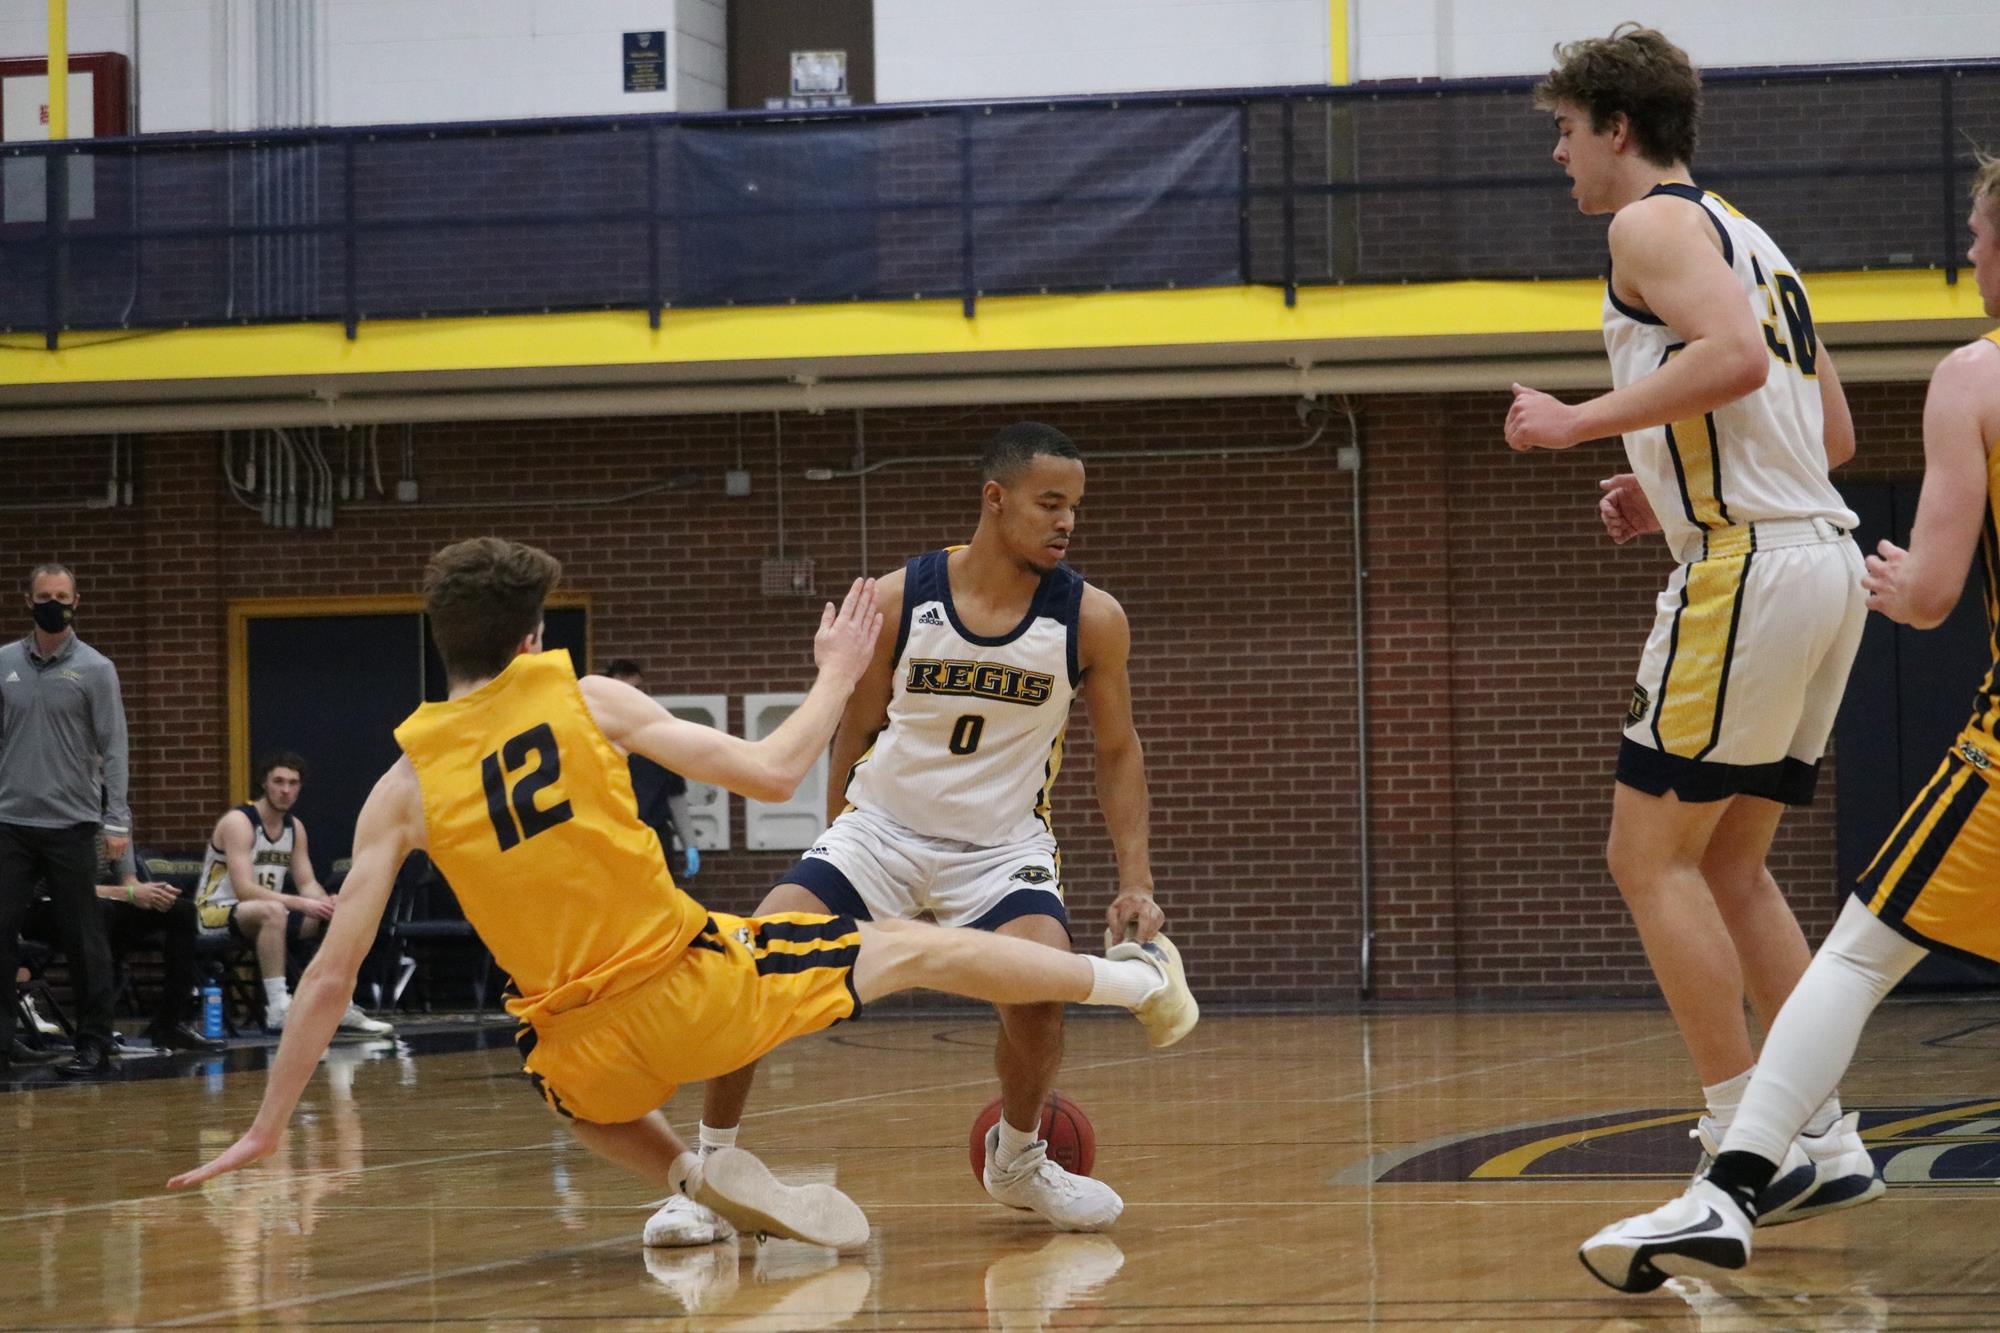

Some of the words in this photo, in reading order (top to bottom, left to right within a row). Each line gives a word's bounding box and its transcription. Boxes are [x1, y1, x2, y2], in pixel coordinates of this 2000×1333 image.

[919, 616, 944, 626] adidas
[906, 658, 1055, 707] REGIS
[949, 714, 985, 755] 0
[481, 722, 574, 853] 12
